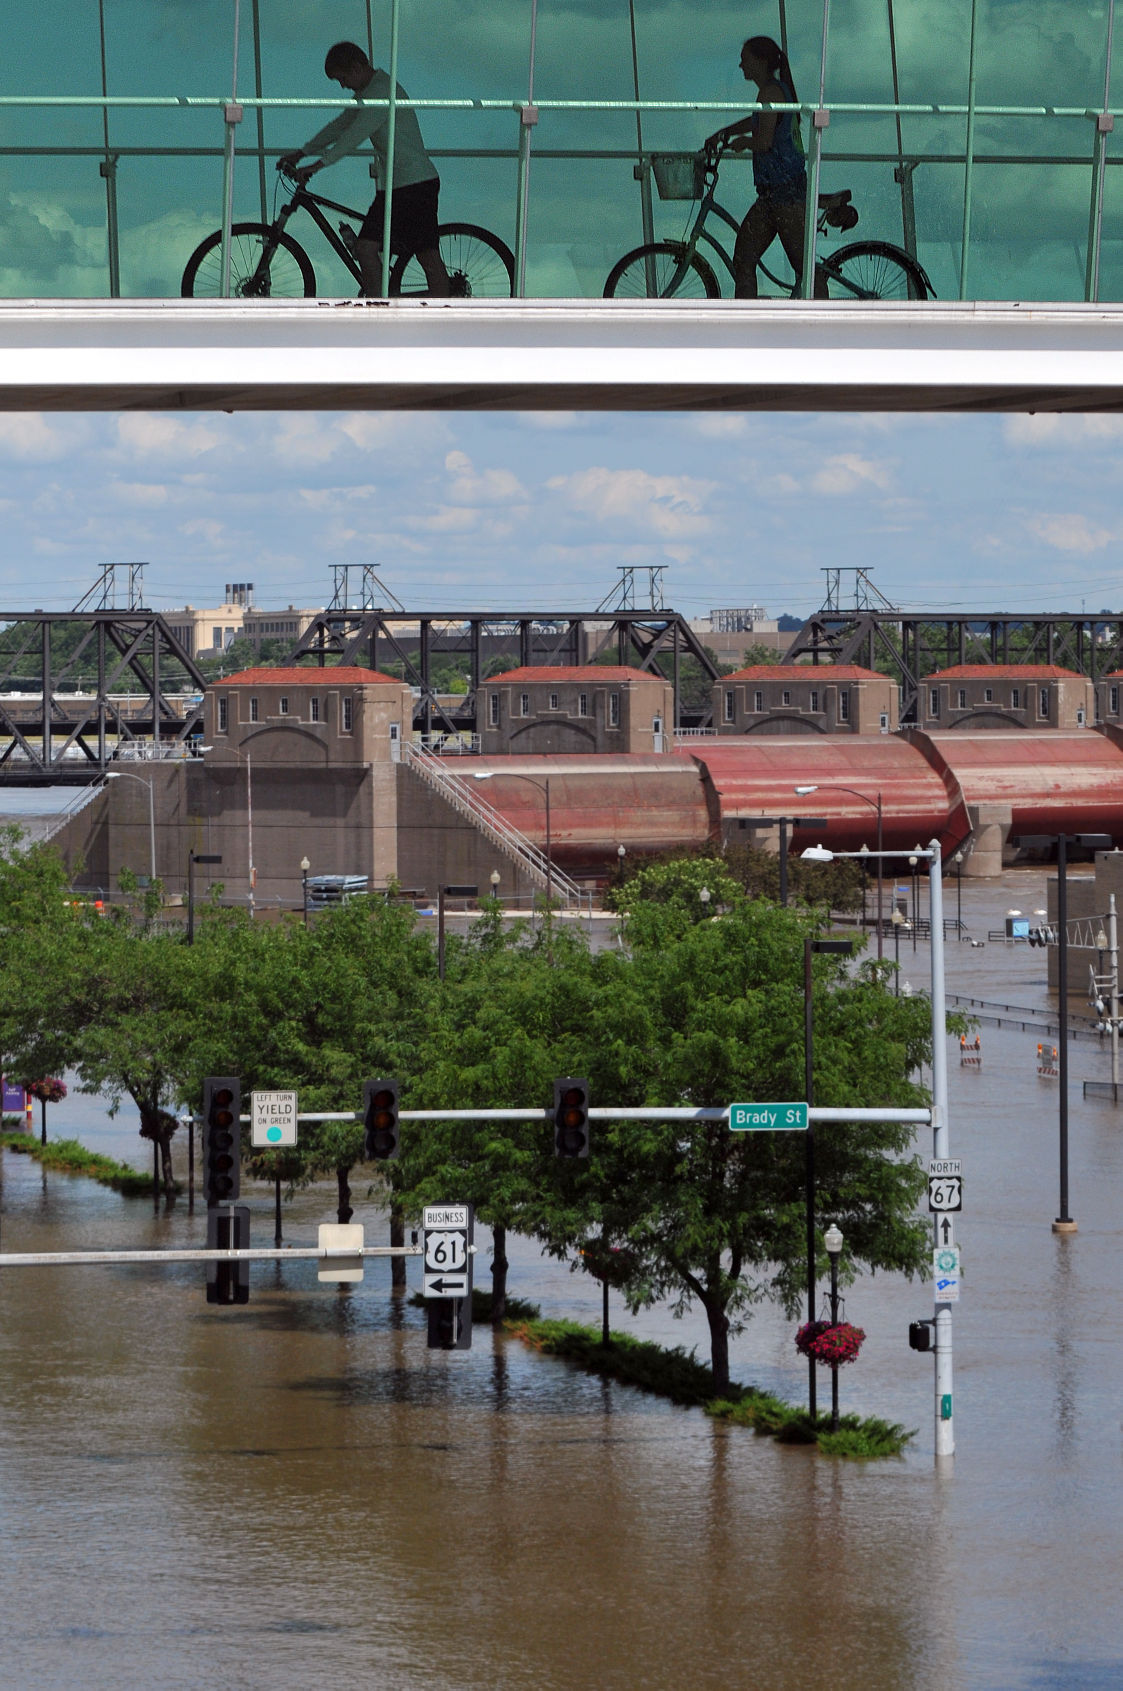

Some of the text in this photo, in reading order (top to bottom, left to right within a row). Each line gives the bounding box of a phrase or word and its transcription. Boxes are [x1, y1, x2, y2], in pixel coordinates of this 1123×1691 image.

[256, 1094, 293, 1102] LEFT TURN
[257, 1104, 293, 1115] YIELD
[257, 1117, 291, 1125] ON GREEN
[736, 1109, 802, 1127] Brady St
[930, 1162, 960, 1174] NORTH
[934, 1184, 956, 1204] 67
[427, 1211, 464, 1224] BUSINESS
[434, 1240, 456, 1264] 61
